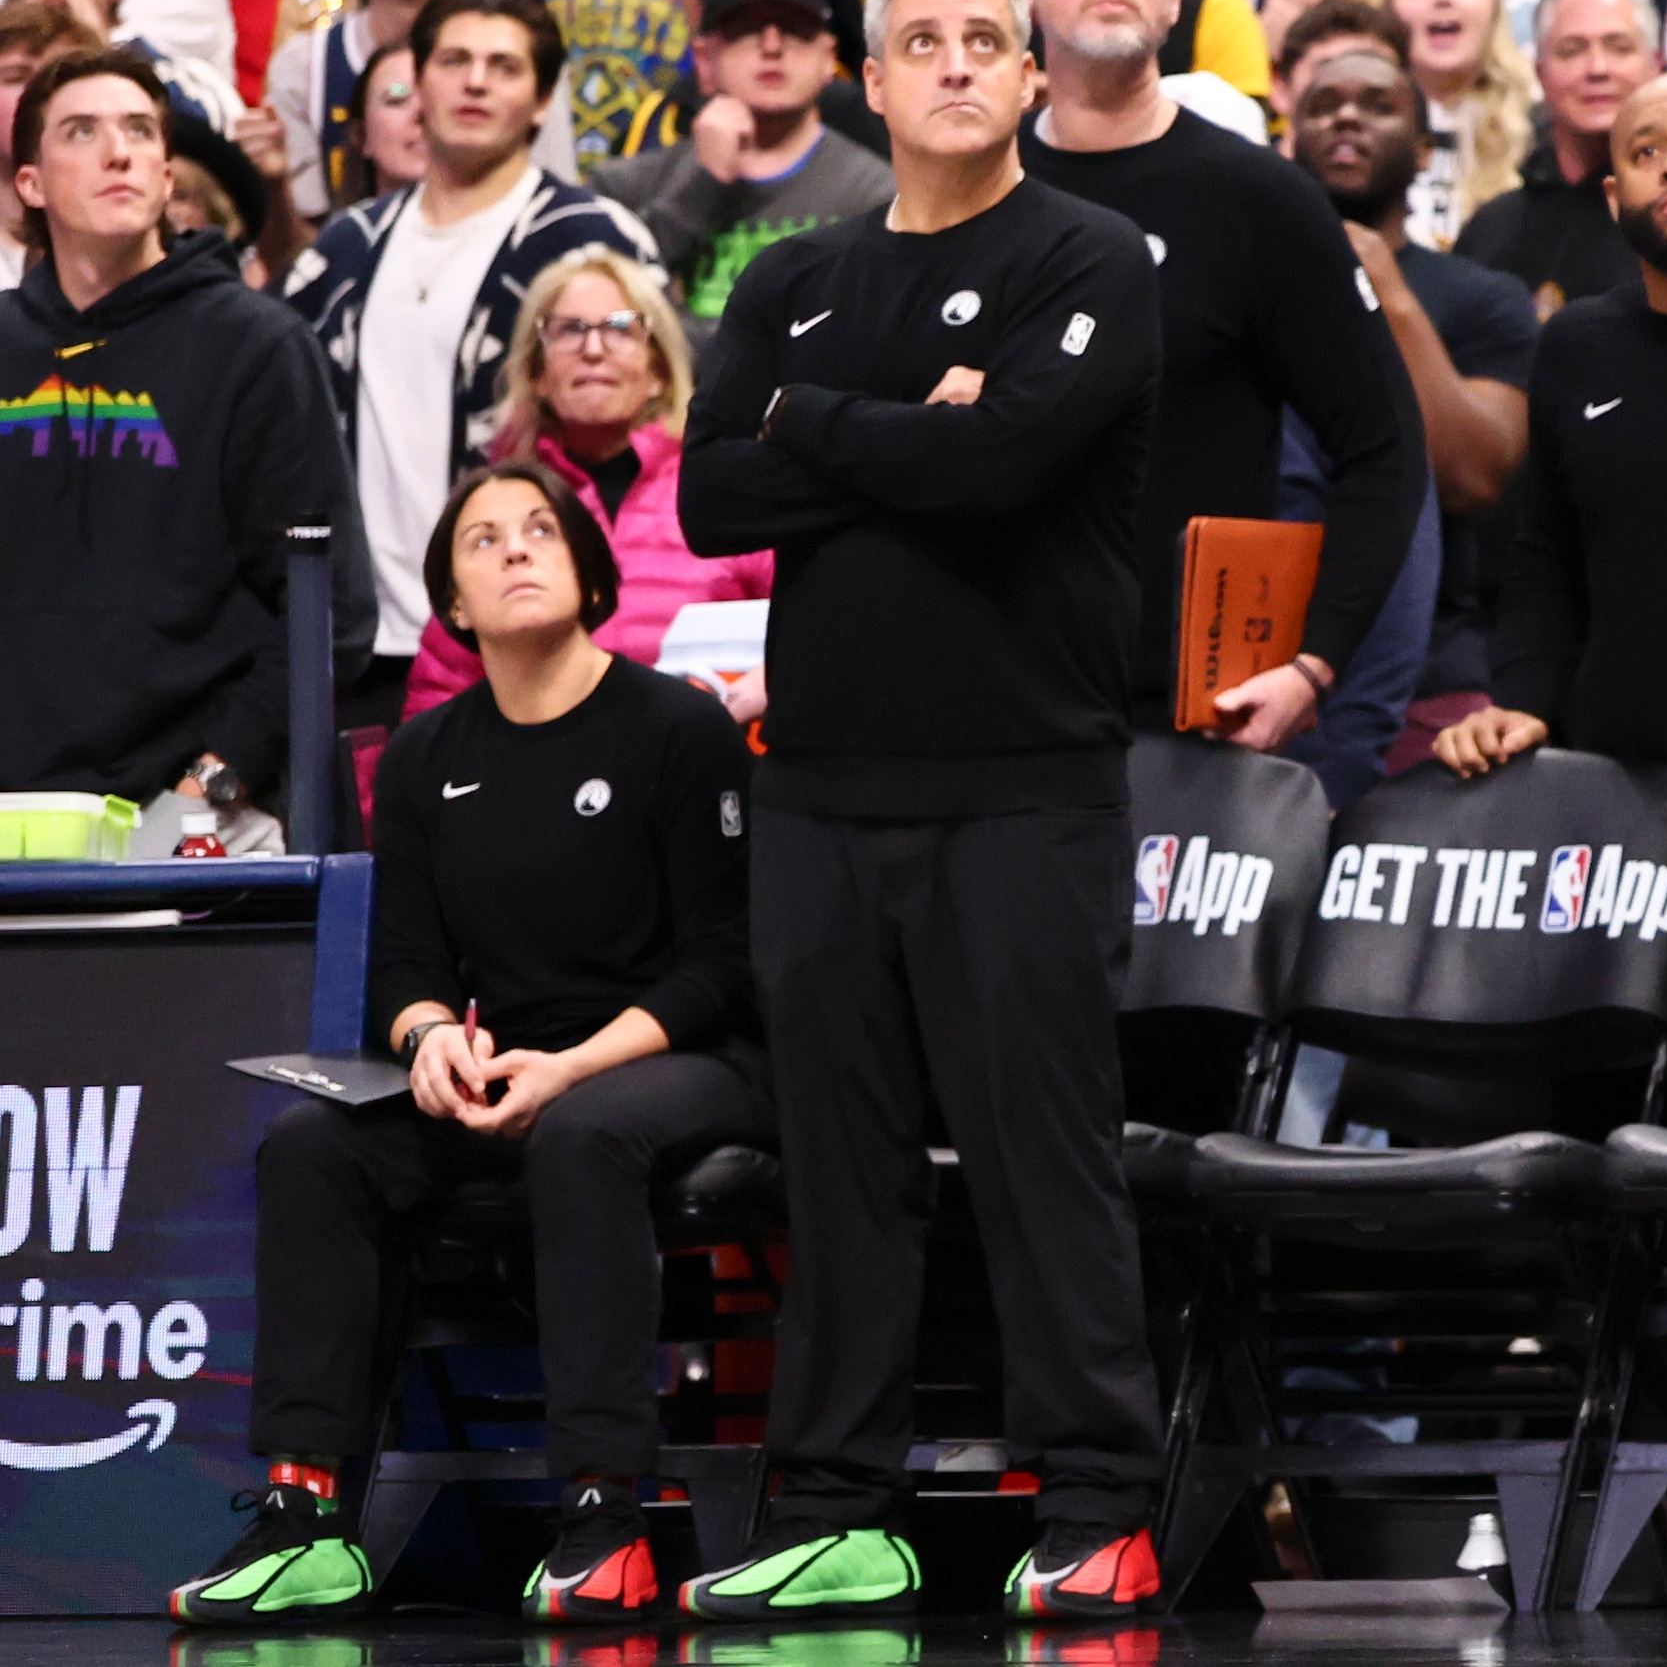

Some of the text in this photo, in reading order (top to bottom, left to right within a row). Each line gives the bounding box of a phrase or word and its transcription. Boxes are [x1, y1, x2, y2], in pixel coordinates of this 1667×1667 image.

[1168, 836, 1274, 936] App
[1319, 843, 1428, 924] GET
[1432, 848, 1538, 930] THE
